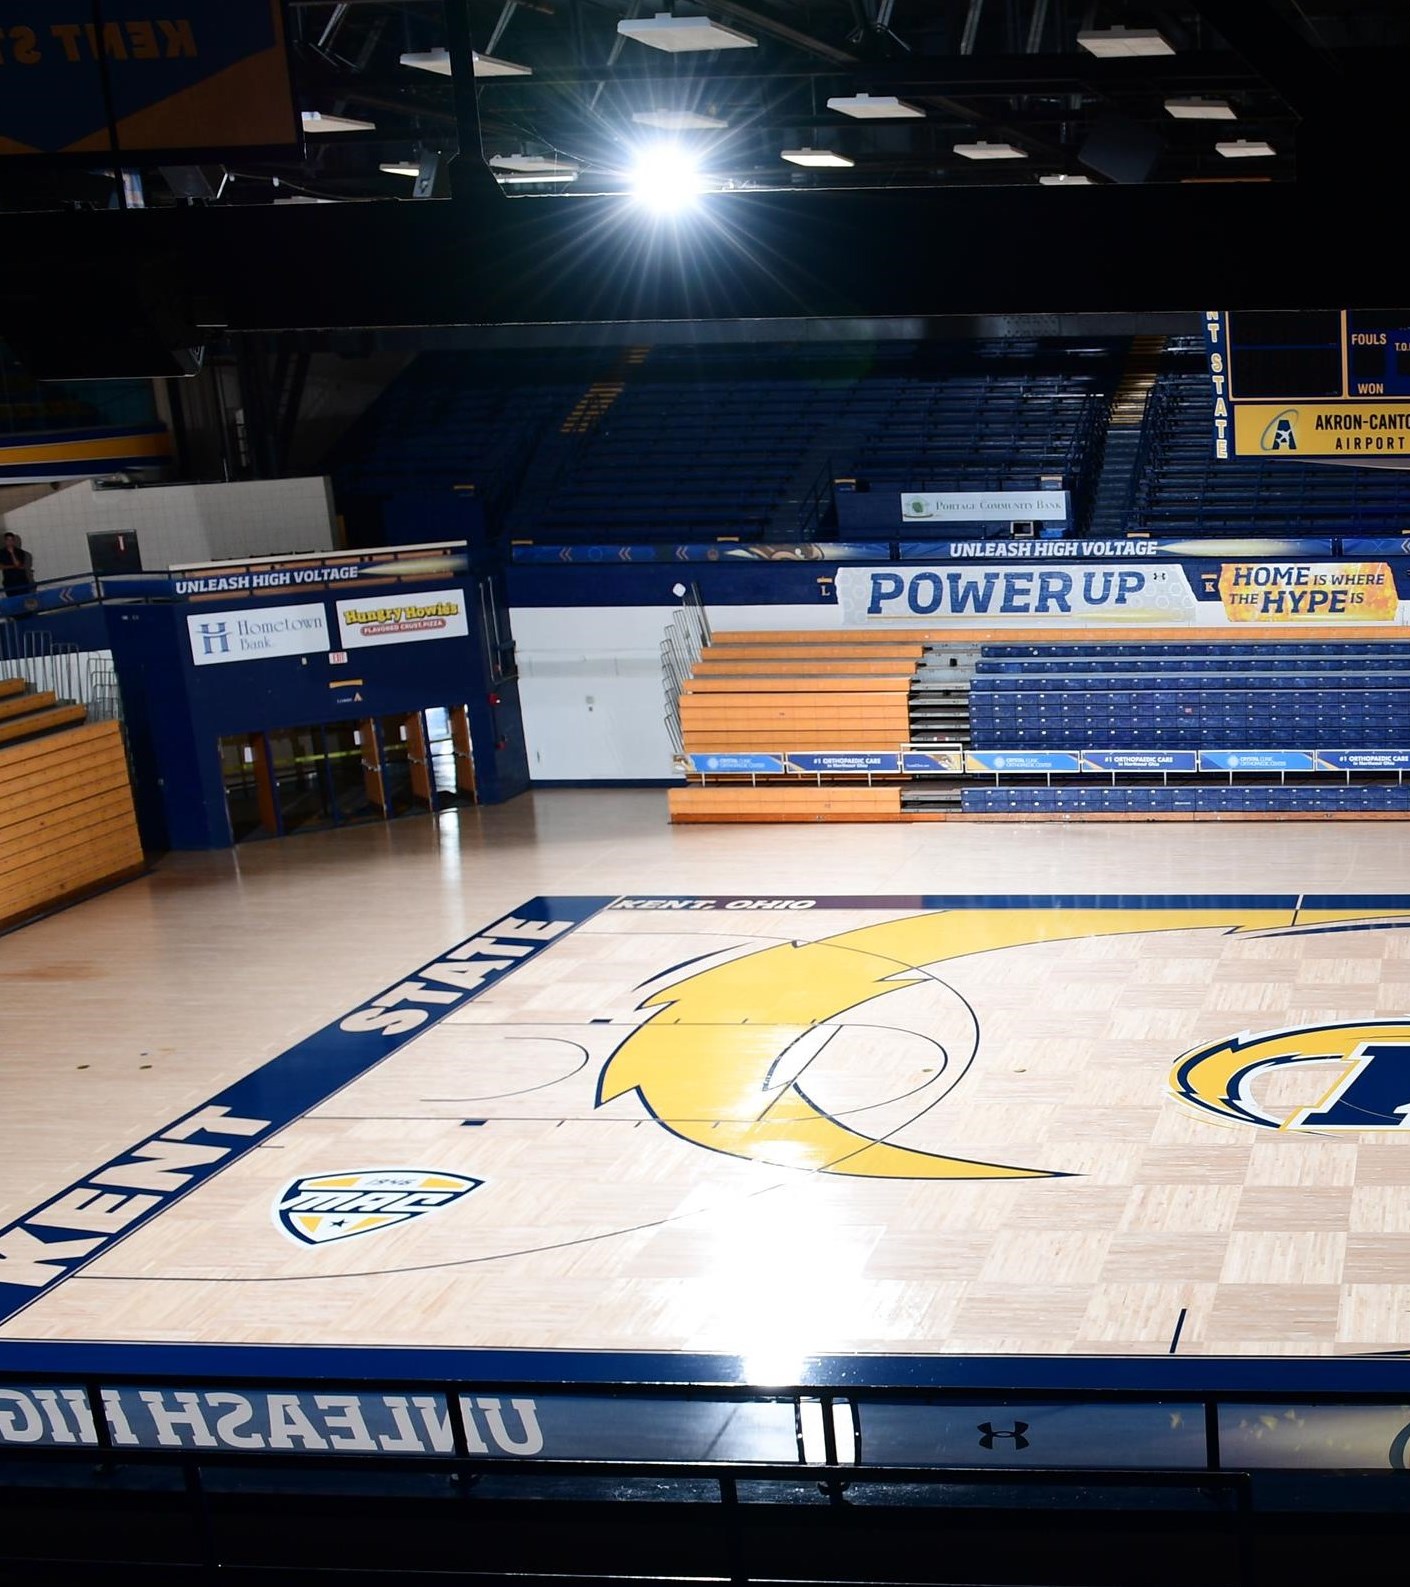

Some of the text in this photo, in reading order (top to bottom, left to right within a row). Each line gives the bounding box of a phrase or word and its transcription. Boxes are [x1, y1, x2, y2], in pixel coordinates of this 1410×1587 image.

[1351, 334, 1387, 345] FOULS
[1357, 383, 1384, 394] WON
[1210, 352, 1228, 459] STATE
[1335, 437, 1405, 450] AIRPORT
[950, 541, 1158, 557] UNLEASH HIGH VOLTAGE
[175, 566, 358, 594] UNLEASH HIGH VOLTAGE
[1232, 566, 1385, 586] HOME IS WHERE
[867, 570, 1147, 615] POWER UP
[1229, 590, 1364, 613] THE HYPE IS
[238, 618, 322, 637] Hometown
[240, 637, 271, 651] Bank
[725, 899, 817, 909] OHIO
[339, 916, 576, 1036] STATE
[0, 1104, 273, 1288] KENT
